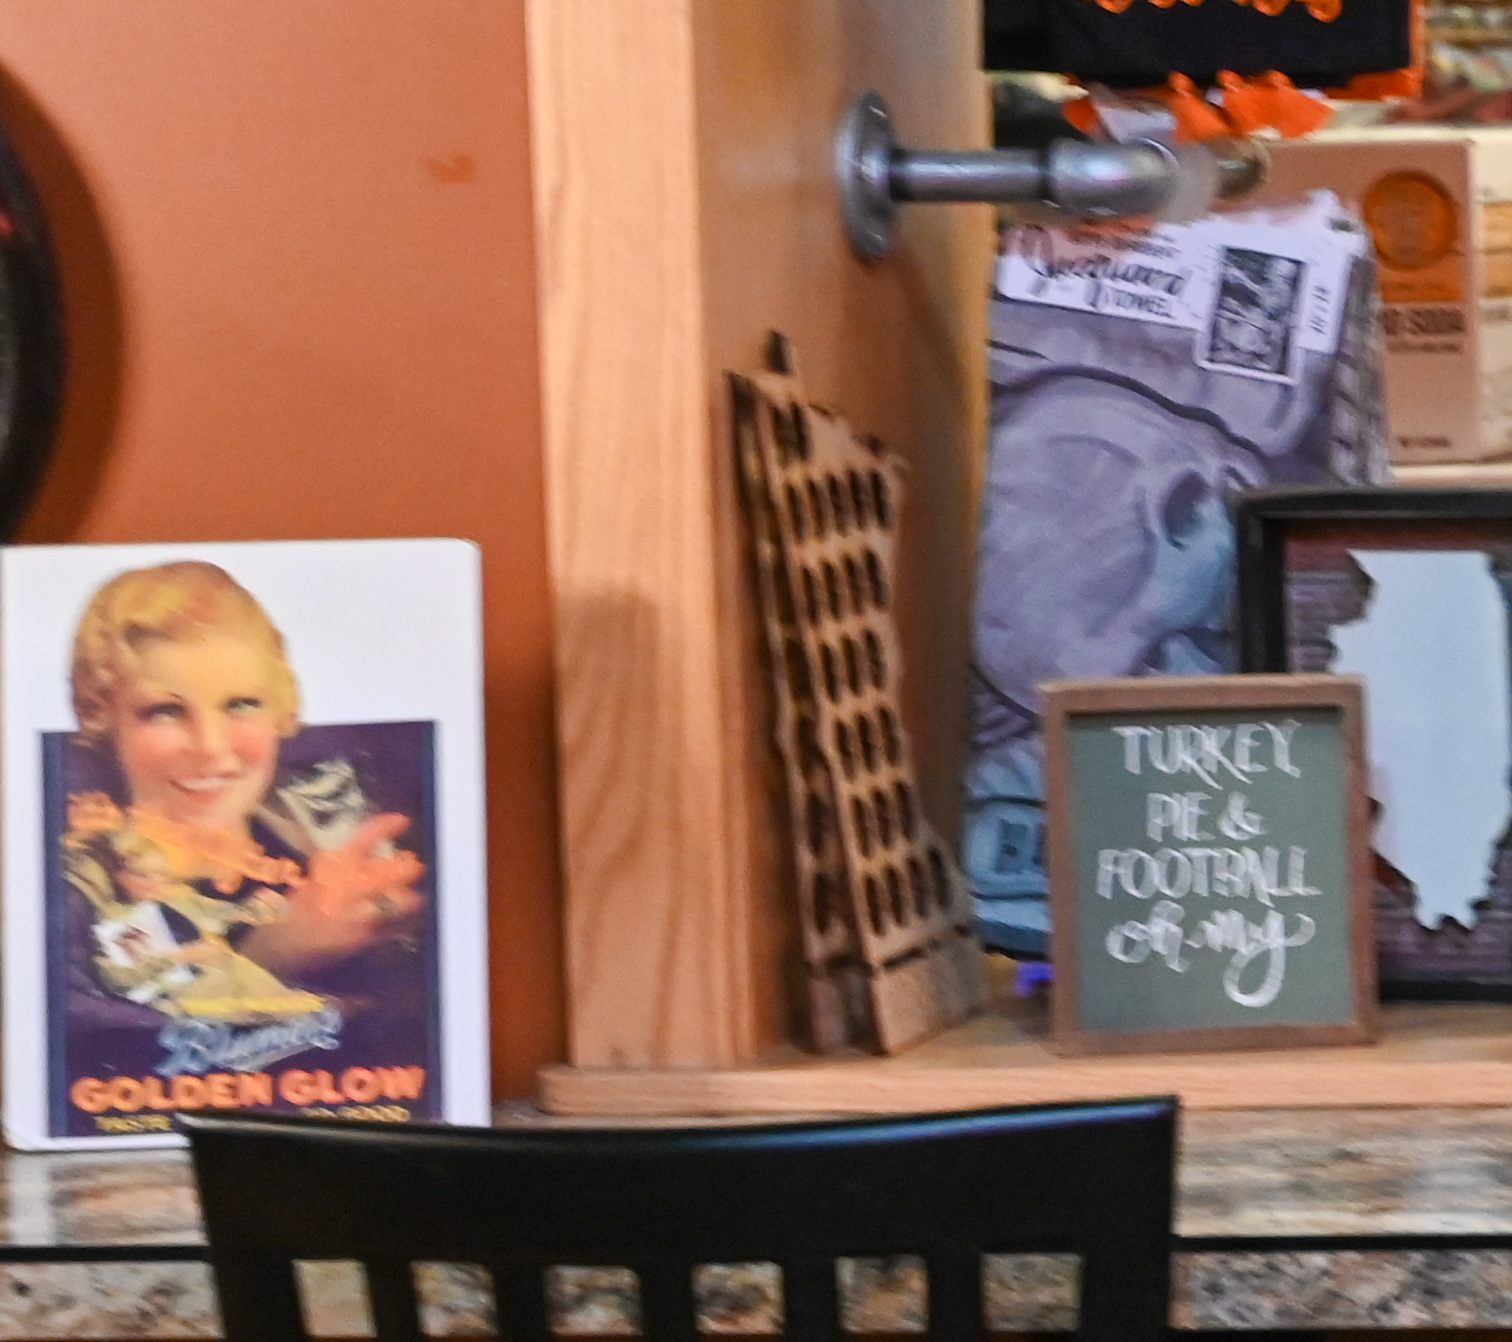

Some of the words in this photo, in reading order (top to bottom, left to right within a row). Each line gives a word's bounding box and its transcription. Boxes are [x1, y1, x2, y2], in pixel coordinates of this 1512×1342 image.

[1112, 719, 1301, 790] TURKEY
[1146, 792, 1216, 843] PIE
[1217, 792, 1268, 841] &
[1096, 845, 1323, 909] FOOTBALL
[1106, 900, 1191, 973] oh
[1184, 908, 1317, 1008] my
[70, 1073, 275, 1113] GOLDEN
[278, 1065, 426, 1106] GLOW
